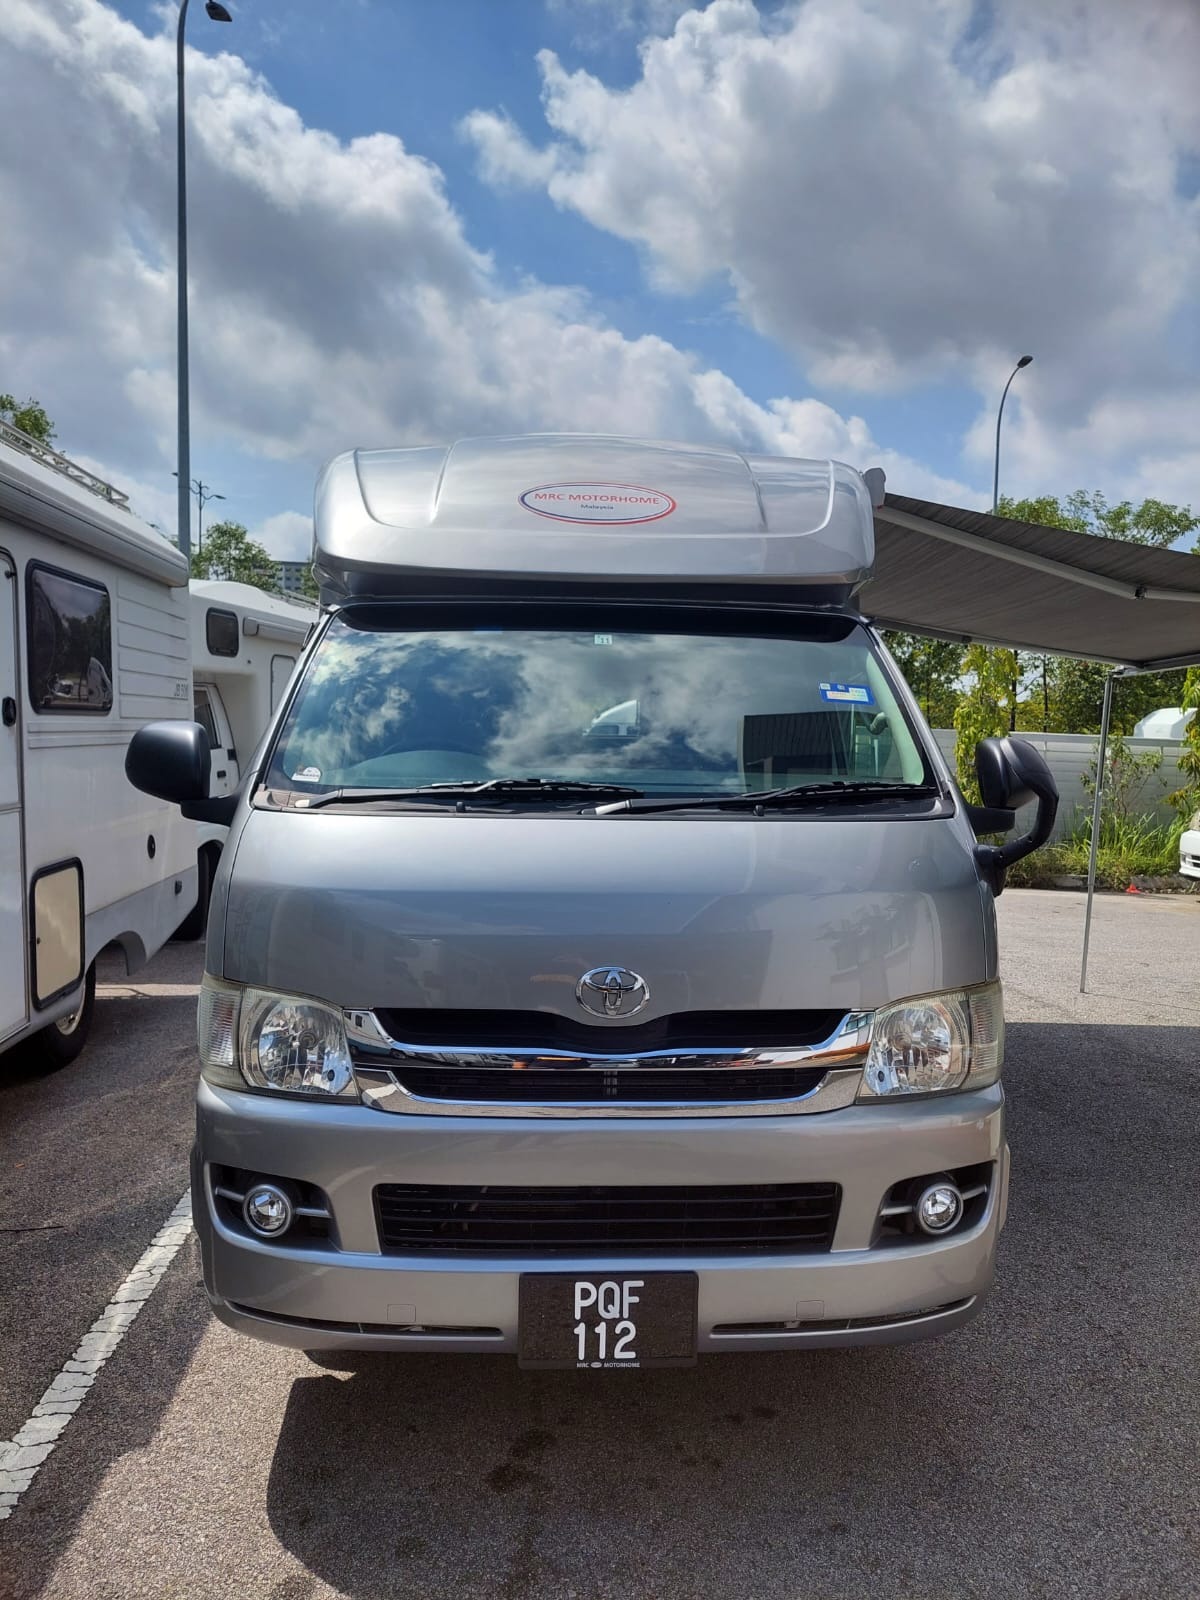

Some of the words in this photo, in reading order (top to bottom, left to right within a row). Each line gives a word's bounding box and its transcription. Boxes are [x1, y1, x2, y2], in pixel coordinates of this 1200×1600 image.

[568, 494, 660, 505] MOTORHOME
[574, 1280, 645, 1320] PQF
[573, 1320, 636, 1361] 112
